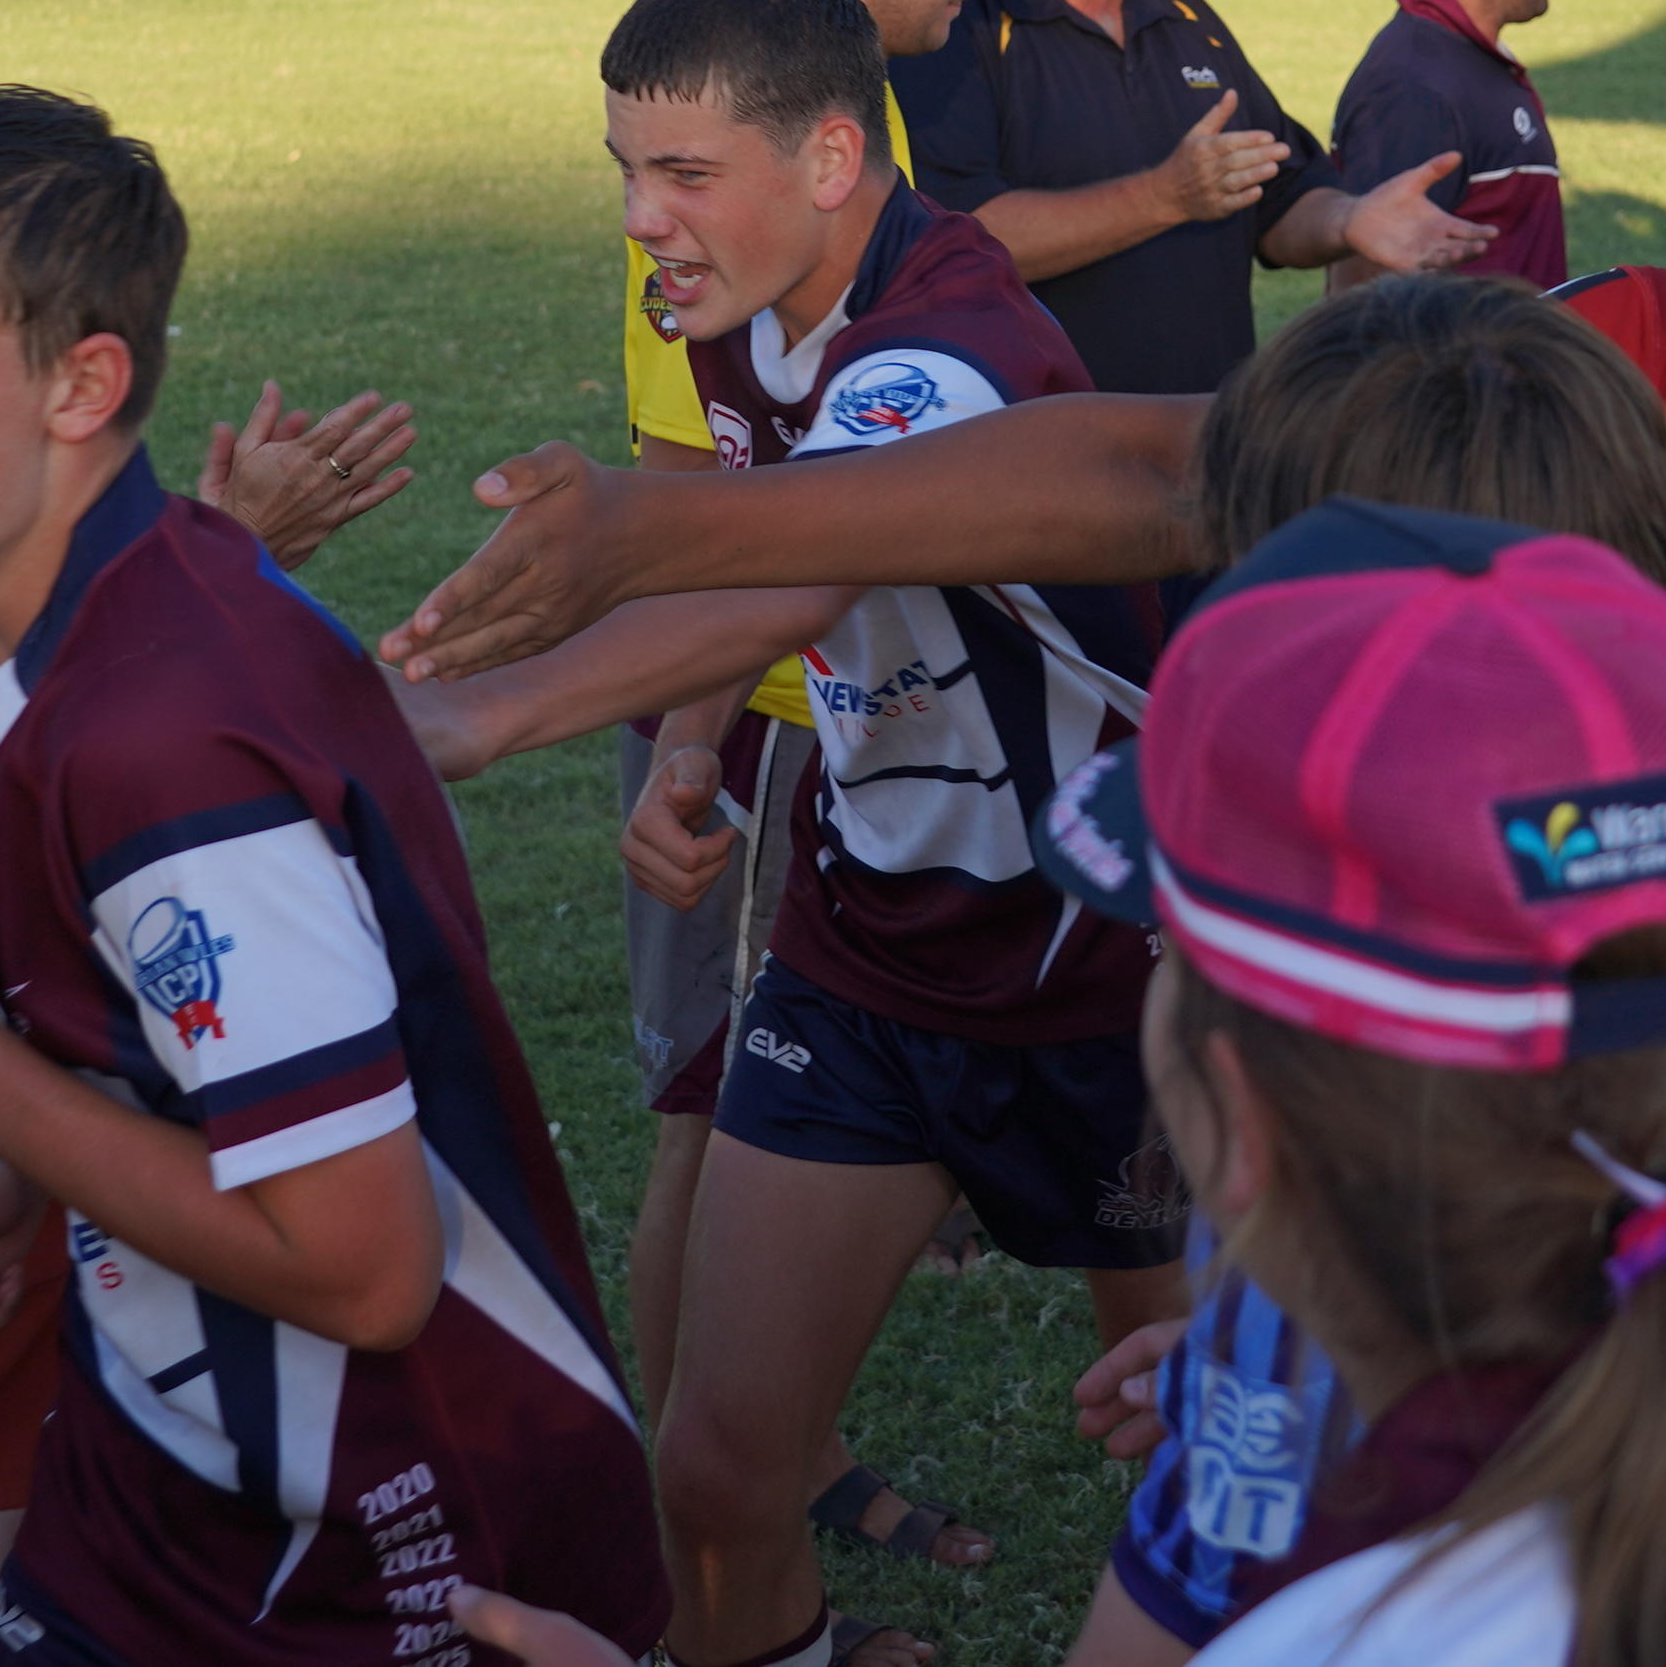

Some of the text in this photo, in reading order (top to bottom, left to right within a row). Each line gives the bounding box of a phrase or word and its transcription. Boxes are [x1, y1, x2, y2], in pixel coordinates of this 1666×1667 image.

[356, 1461, 437, 1526] 2020
[370, 1502, 445, 1553] 2021
[378, 1532, 459, 1579] 2022
